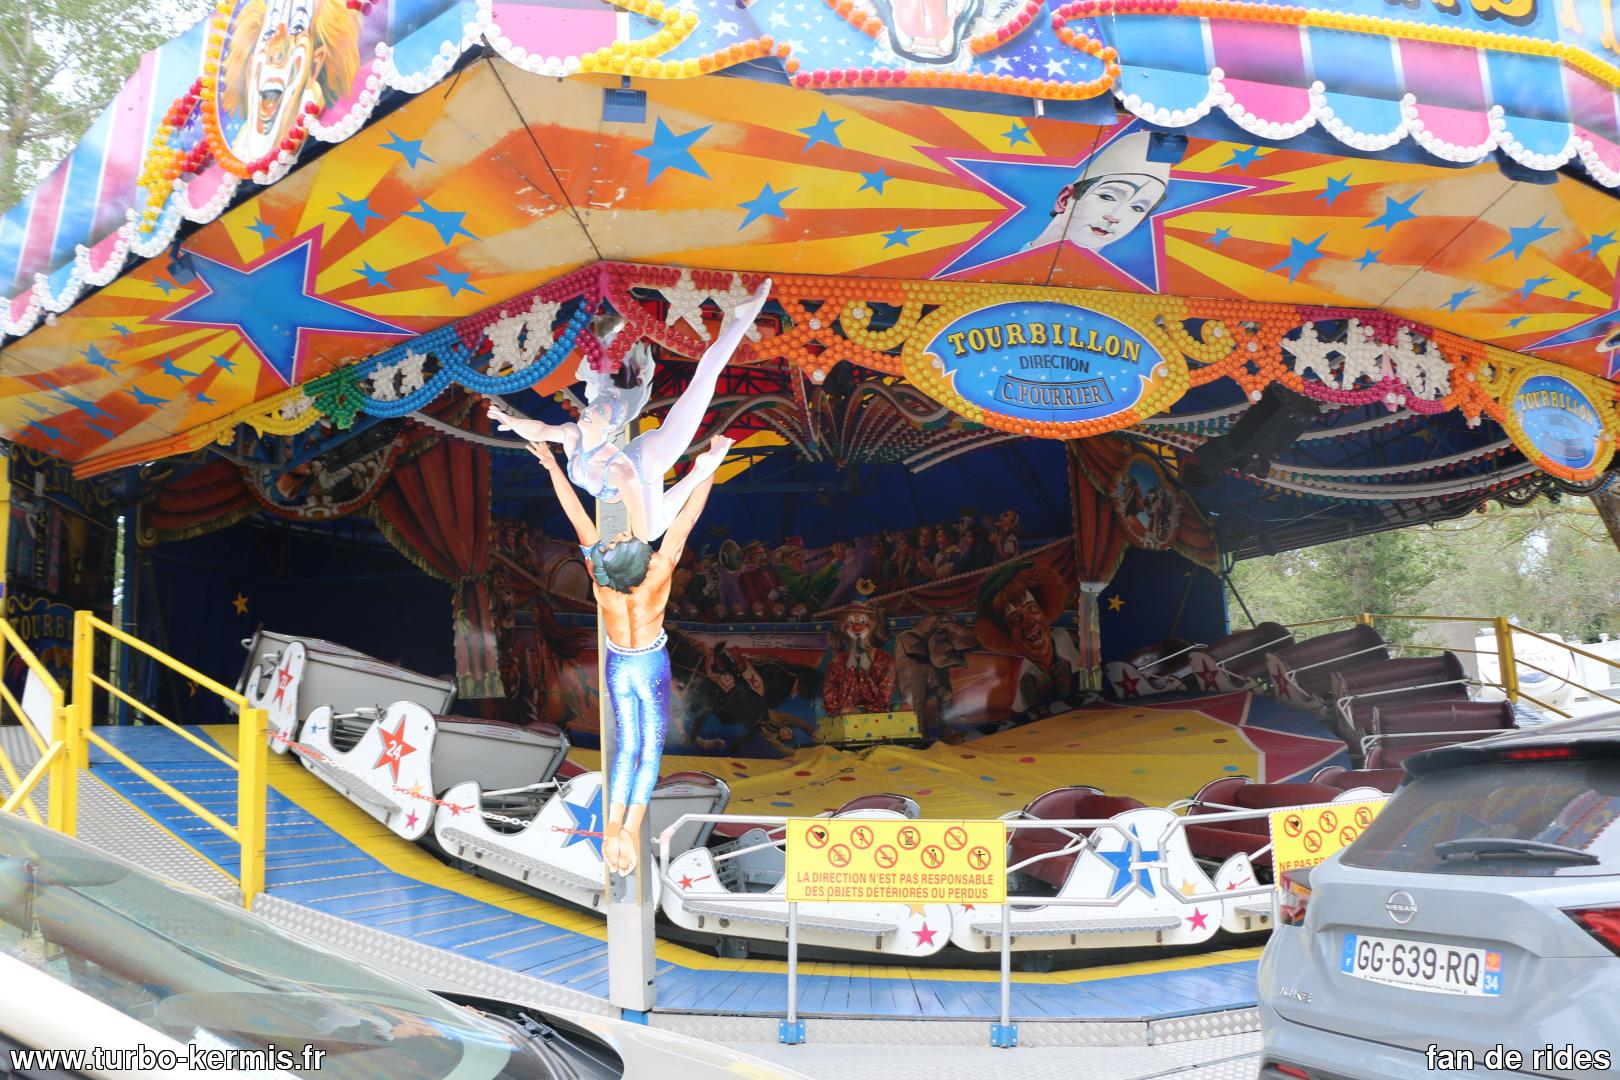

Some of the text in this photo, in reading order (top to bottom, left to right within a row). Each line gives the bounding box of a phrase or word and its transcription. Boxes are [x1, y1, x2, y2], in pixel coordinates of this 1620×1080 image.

[947, 321, 1142, 364] TOURBILLON
[1019, 355, 1090, 374] DIRECTION
[1518, 390, 1594, 426] TOURBILLON
[386, 740, 403, 757] 24
[797, 872, 995, 885] LA DIRECTION N'EST PAS RESPONSABLE
[805, 886, 825, 897] DES
[827, 886, 864, 898] OBJETS
[932, 887, 945, 898] OU
[948, 888, 989, 899] PERDUS
[1385, 903, 1418, 913] NISSAN
[1357, 939, 1480, 987] GG-639-RQ
[1484, 974, 1500, 991] 34
